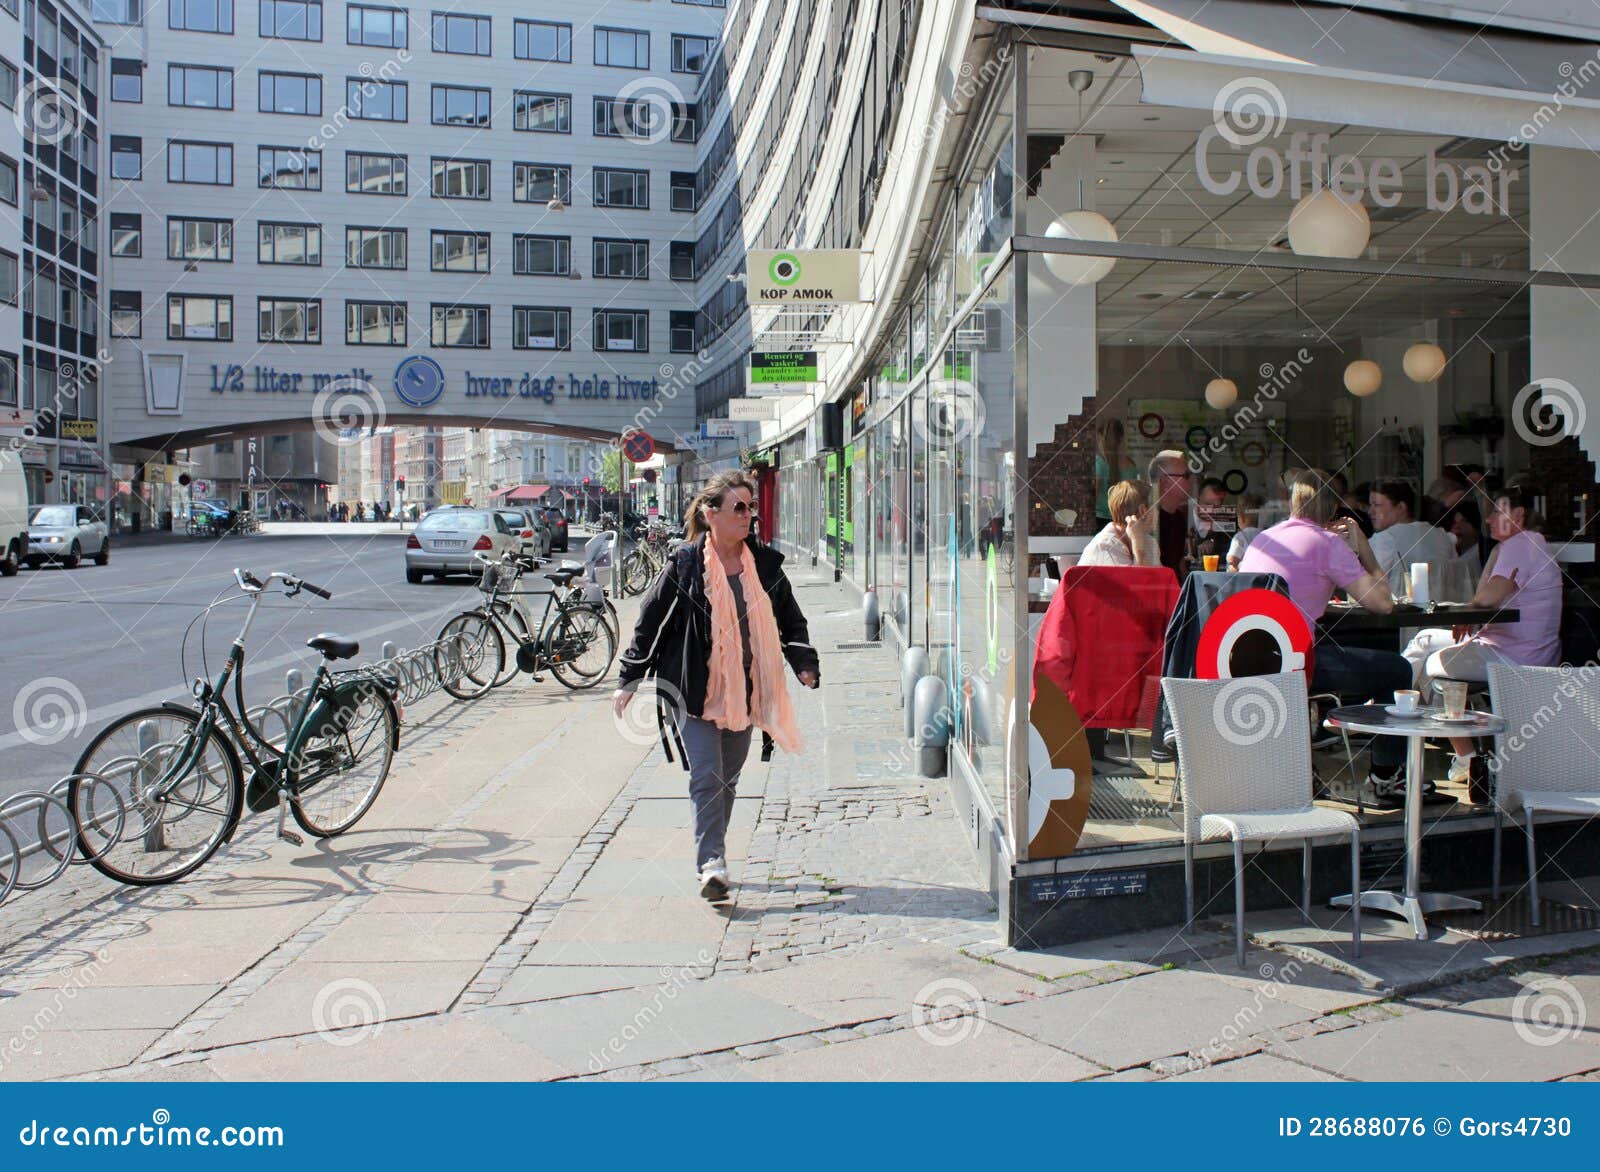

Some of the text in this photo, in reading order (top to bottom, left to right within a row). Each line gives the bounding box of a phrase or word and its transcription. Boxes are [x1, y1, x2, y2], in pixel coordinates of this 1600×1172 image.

[1195, 125, 1520, 216] Coffee bar
[760, 289, 833, 299] KOP AMOK
[210, 364, 244, 394] 1/2
[254, 365, 303, 394] liter
[465, 370, 512, 398] hver
[616, 374, 658, 401] livet
